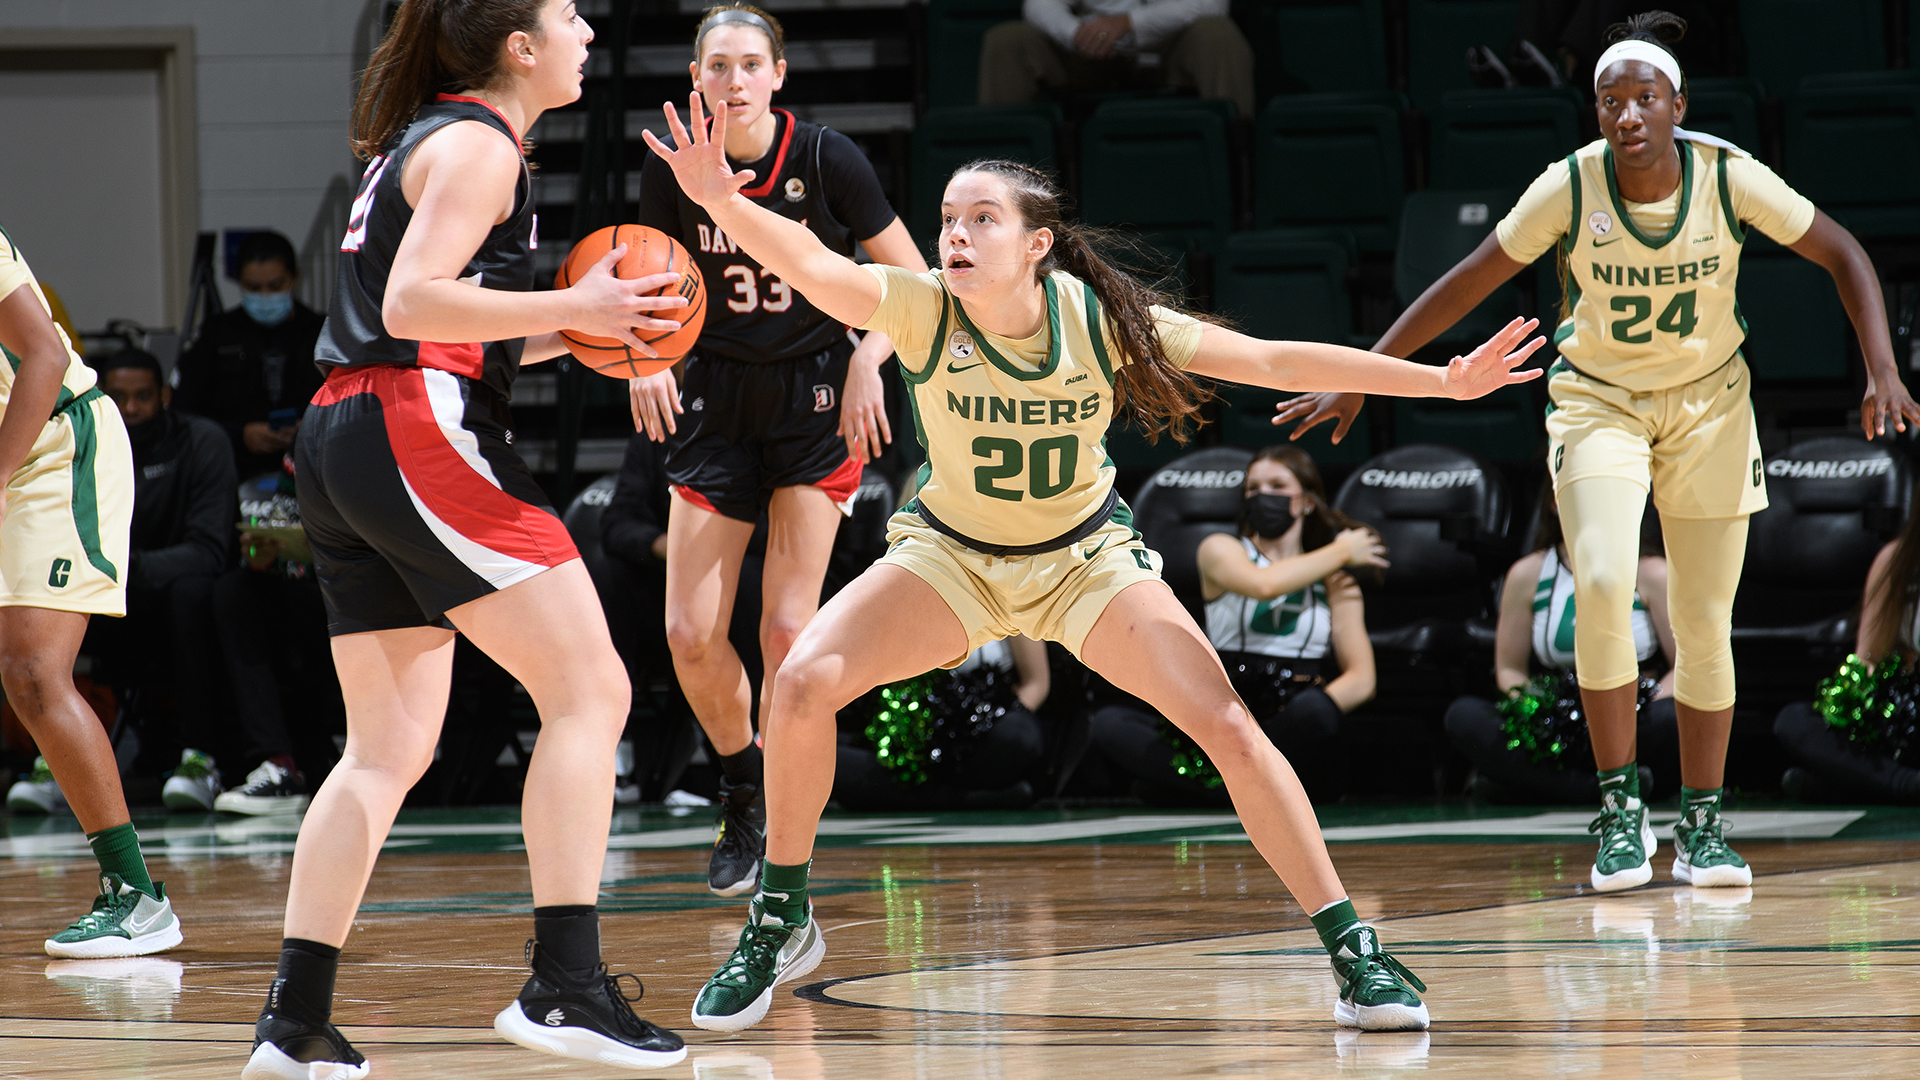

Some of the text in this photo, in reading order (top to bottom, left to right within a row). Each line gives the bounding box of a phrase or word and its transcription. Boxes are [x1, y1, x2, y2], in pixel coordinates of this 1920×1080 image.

[1591, 255, 1720, 287] NINERS
[723, 265, 793, 313] 33
[1610, 288, 1699, 344] 24
[953, 337, 972, 345] GOLD
[946, 389, 1100, 426] NINERS
[972, 434, 1079, 502] 20
[1155, 469, 1247, 489] CHARLO
[1361, 468, 1482, 489] CHARLOTTE
[1767, 458, 1893, 478] CHARLOTTE
[48, 557, 72, 588] C
